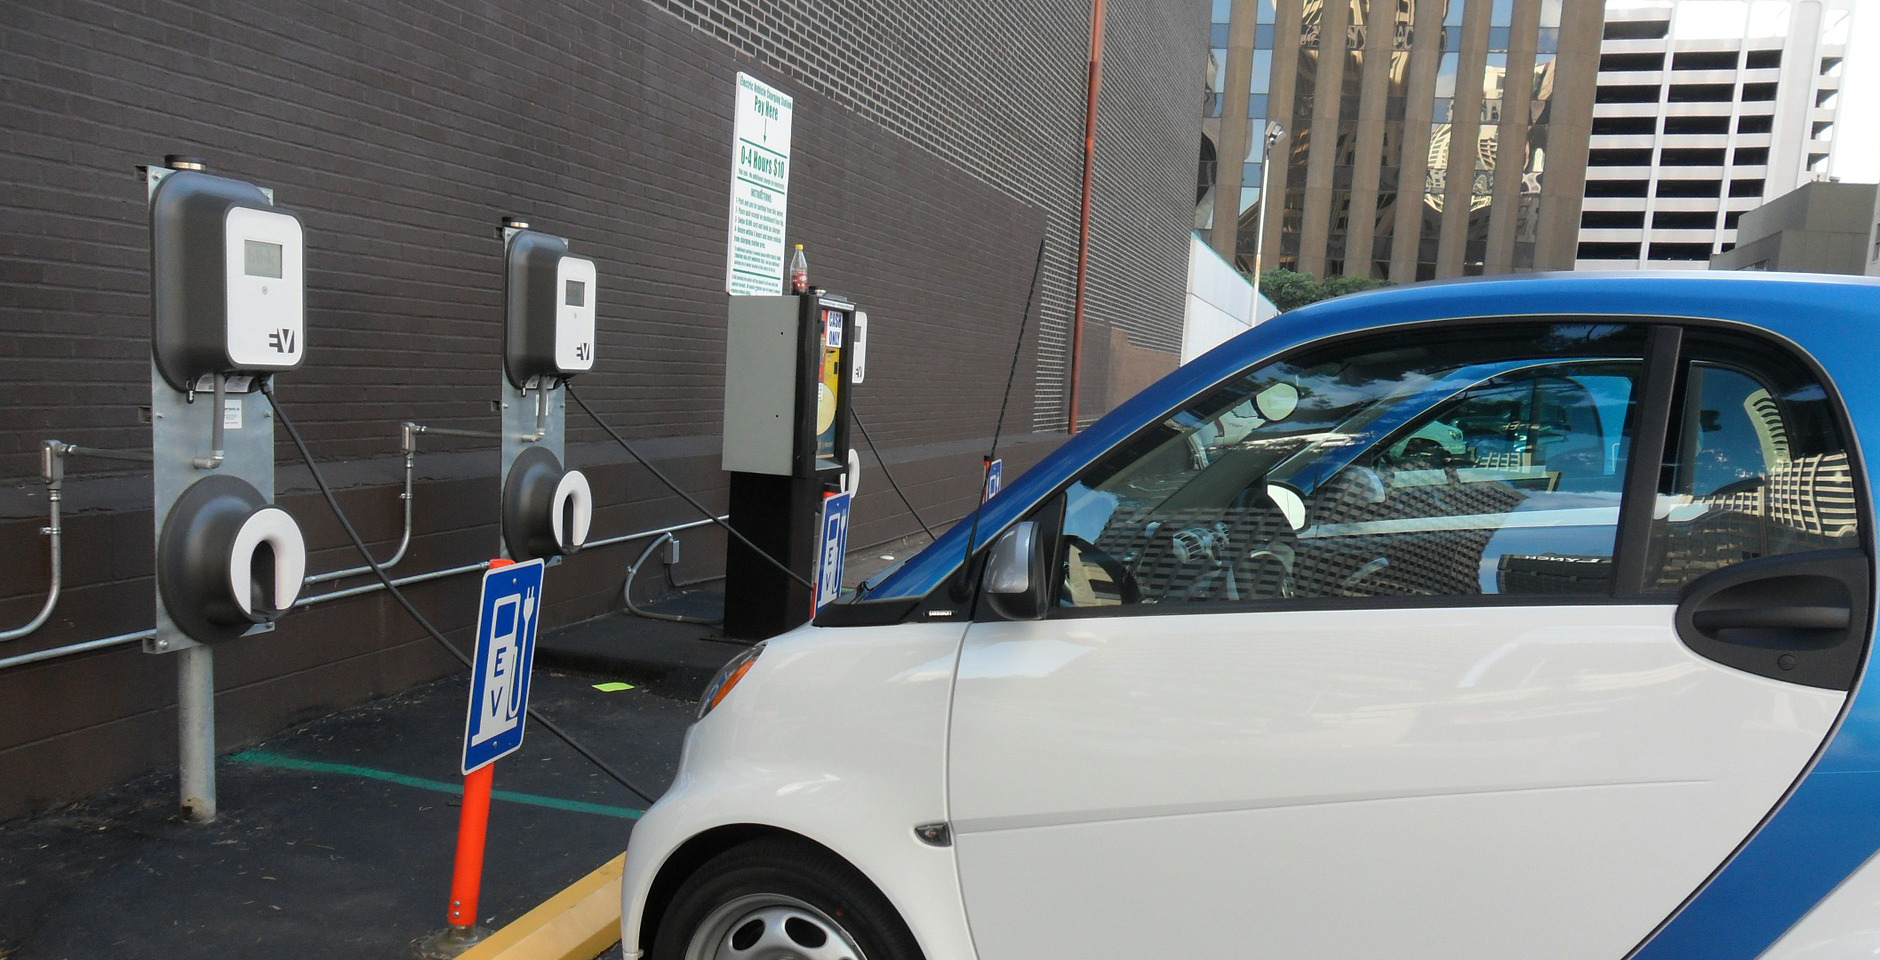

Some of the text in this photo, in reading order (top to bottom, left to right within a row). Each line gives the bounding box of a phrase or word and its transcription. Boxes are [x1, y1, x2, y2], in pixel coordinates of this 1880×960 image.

[754, 95, 778, 121] Pay Here
[753, 150, 772, 175] Hours
[773, 158, 784, 179] $10
[829, 311, 842, 328] CASH
[828, 330, 841, 346] ONLY
